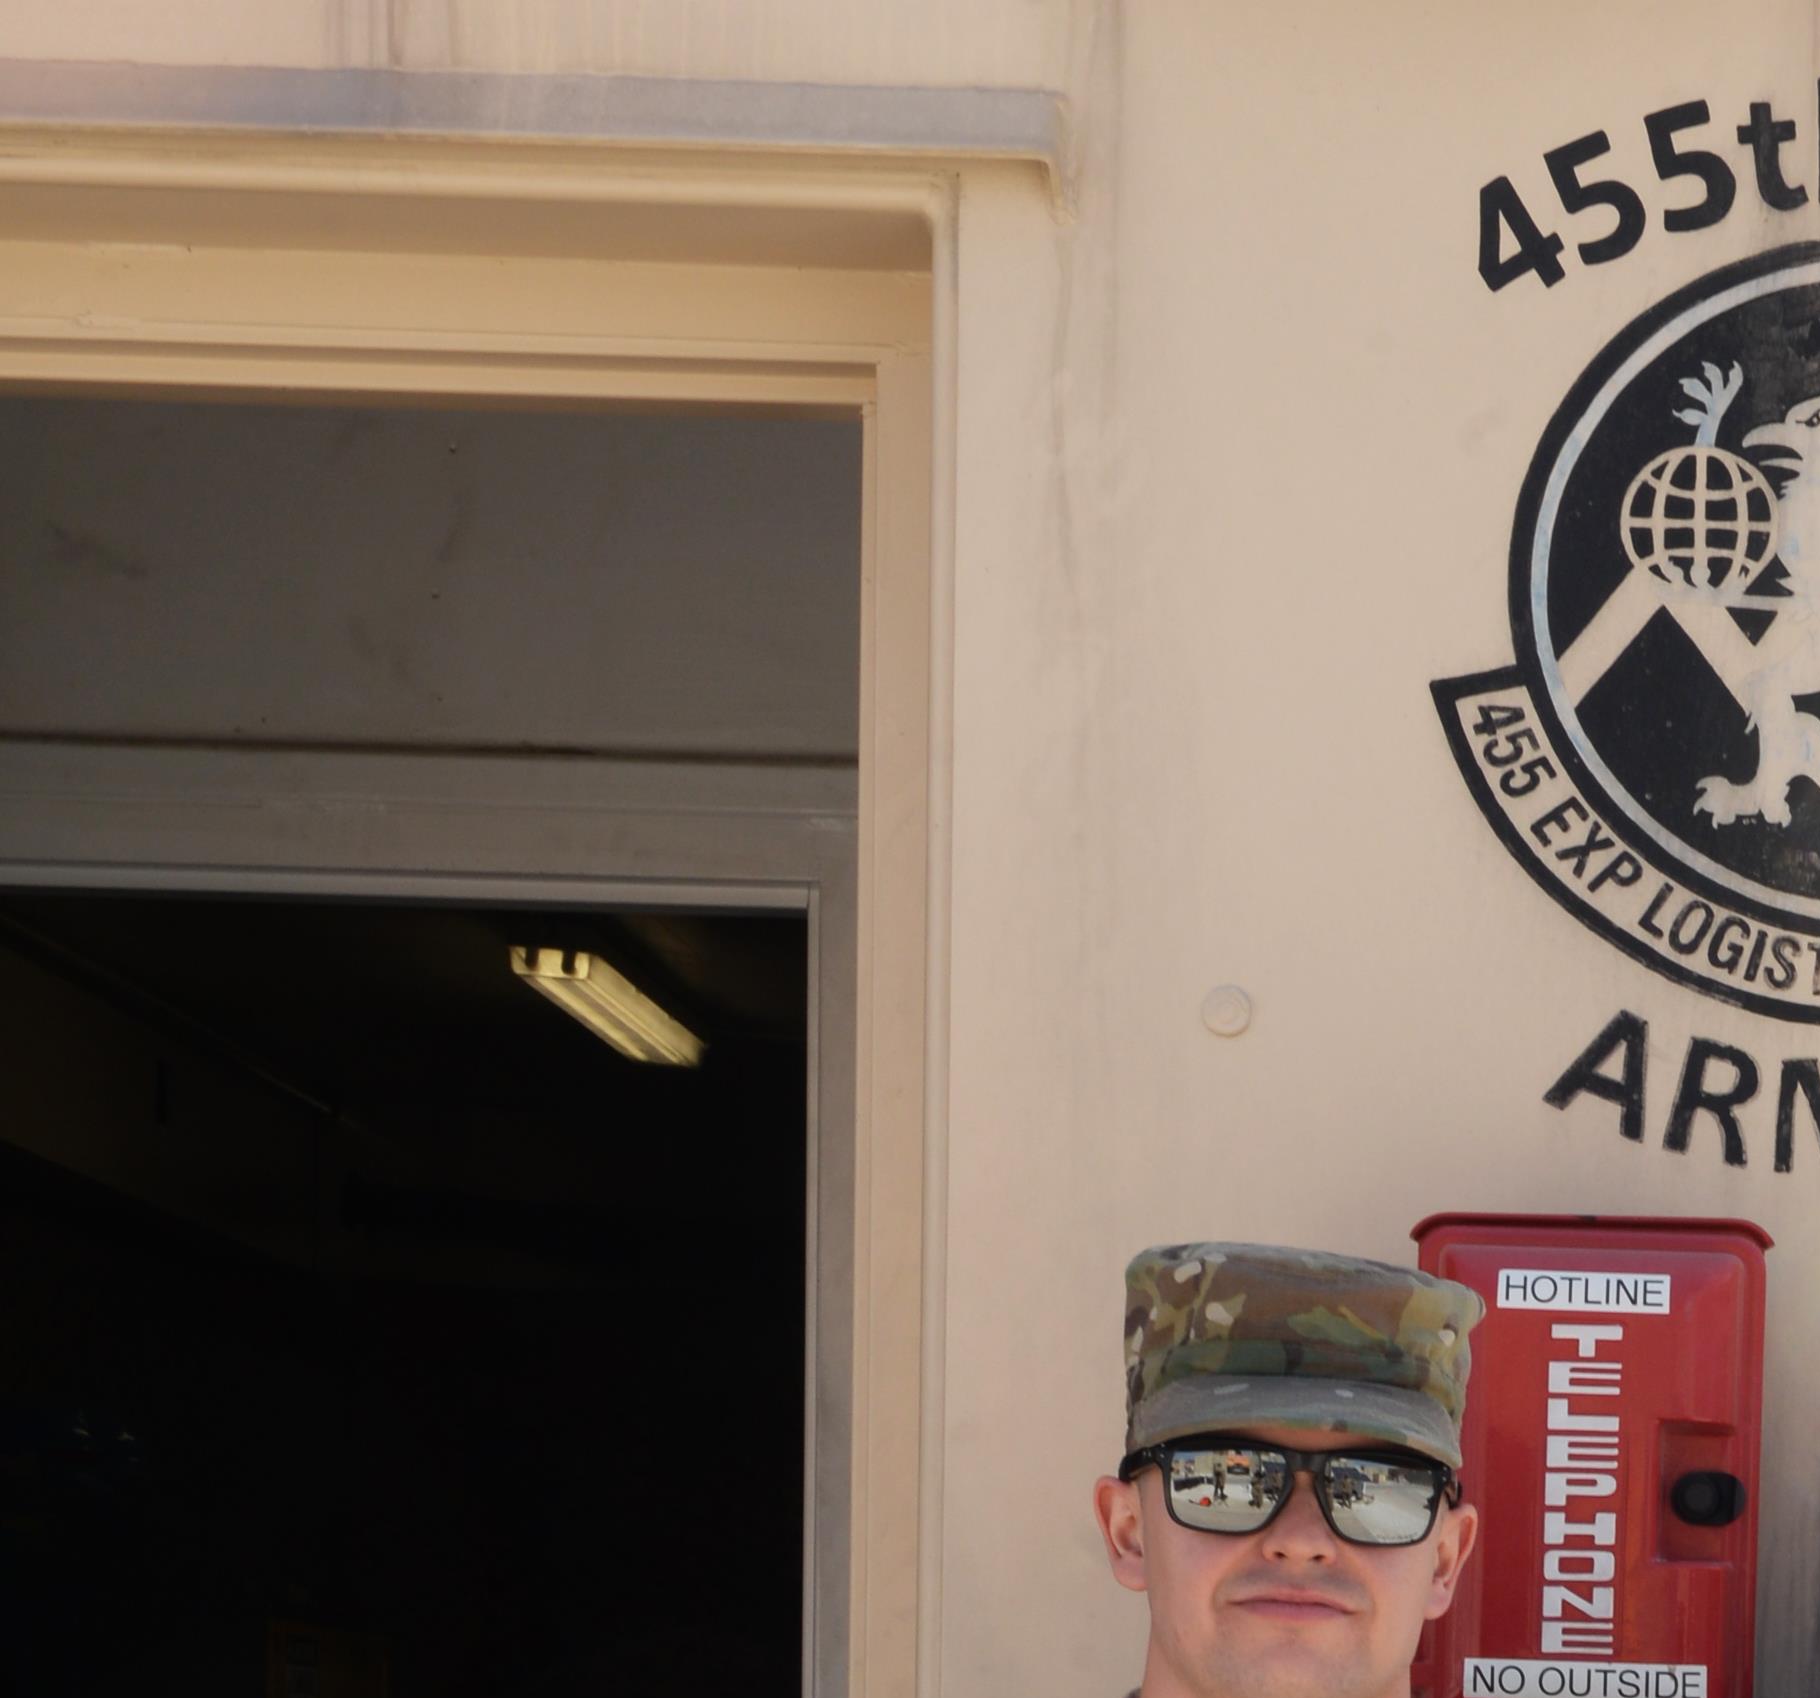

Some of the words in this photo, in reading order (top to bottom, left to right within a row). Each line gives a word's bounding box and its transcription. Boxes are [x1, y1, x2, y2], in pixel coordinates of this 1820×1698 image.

[1469, 700, 1551, 793] 455
[1529, 790, 1643, 892] EXP
[1504, 1274, 1665, 1308] HOTLINE
[1540, 1323, 1624, 1656] TELEPHONE
[1472, 1664, 1526, 1696] NO
